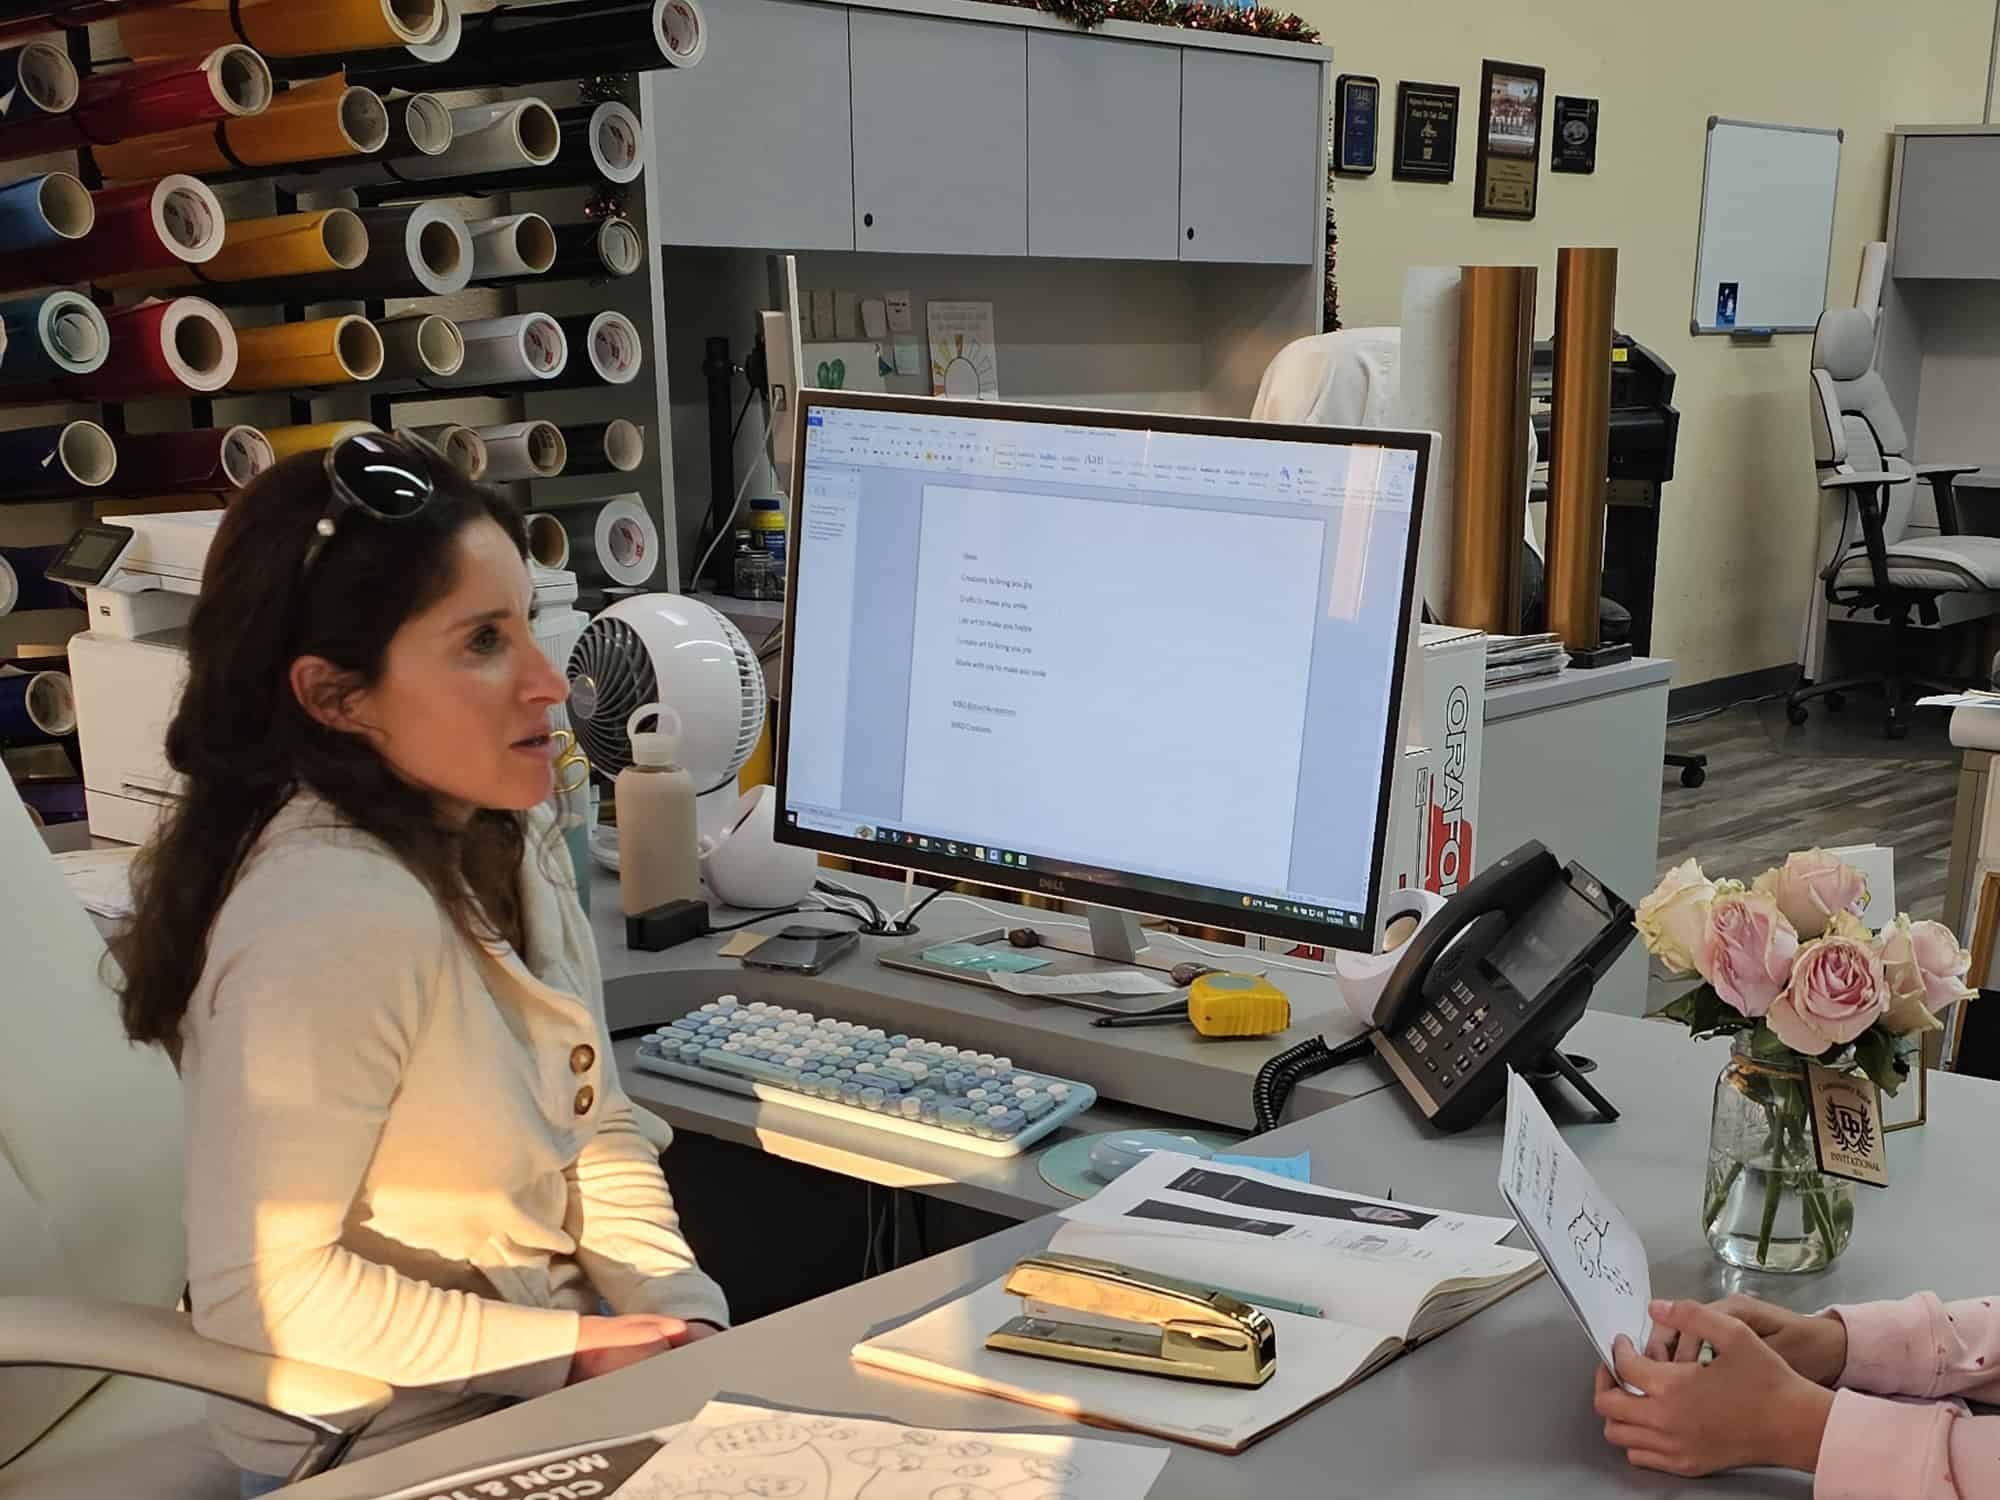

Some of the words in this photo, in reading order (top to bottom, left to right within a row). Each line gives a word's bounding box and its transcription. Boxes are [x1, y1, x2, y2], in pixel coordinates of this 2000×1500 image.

[510, 1453, 610, 1490] MON
[473, 1480, 509, 1497] &
[511, 1479, 605, 1500] CLO
